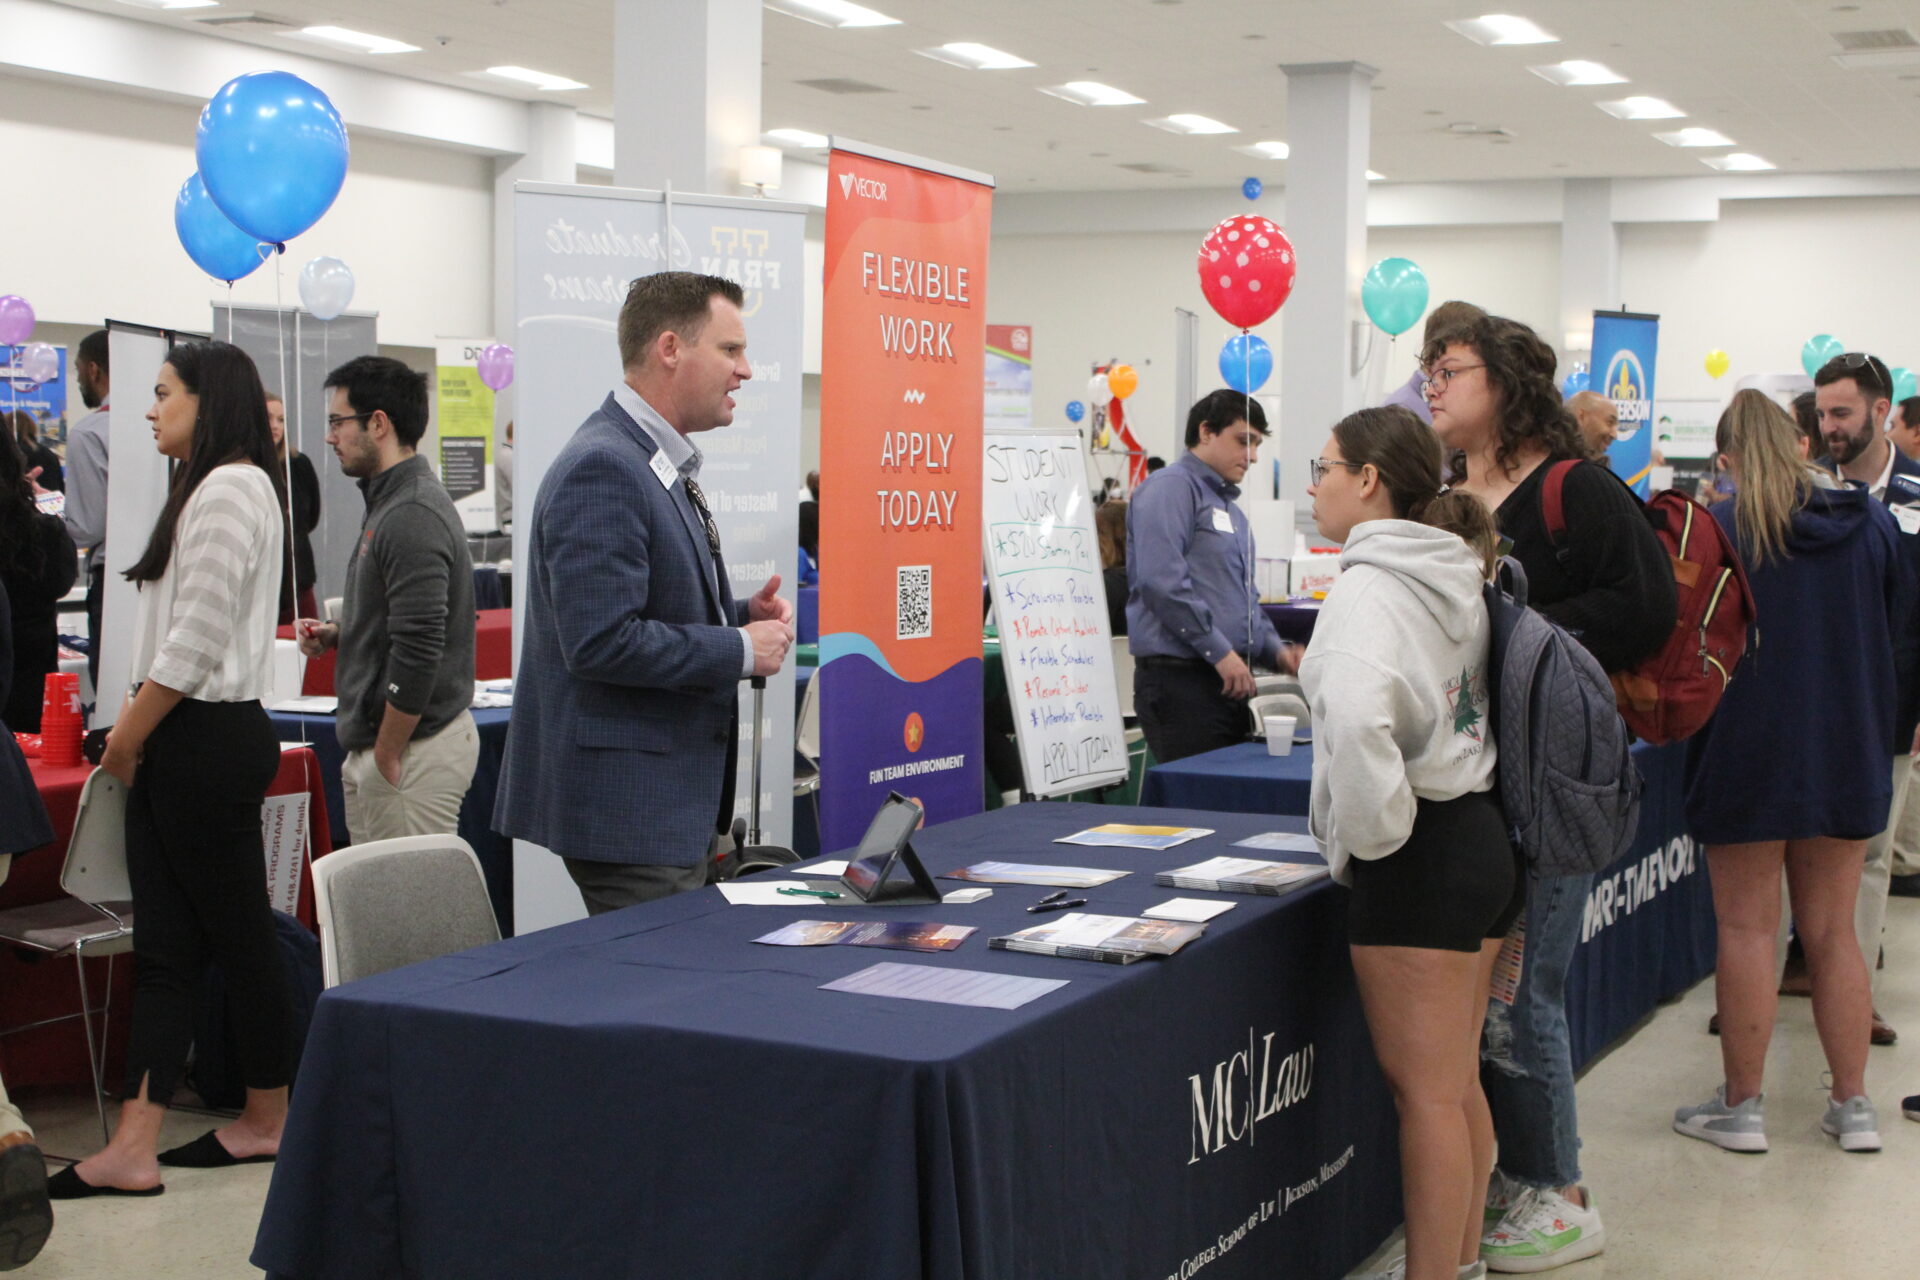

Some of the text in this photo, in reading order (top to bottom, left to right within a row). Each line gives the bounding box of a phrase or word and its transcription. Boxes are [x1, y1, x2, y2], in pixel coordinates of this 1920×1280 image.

[855, 177, 887, 201] VECTOR
[863, 251, 970, 305] FLEXIBLE
[880, 313, 955, 361] WORK
[881, 431, 955, 470] APPLY
[986, 444, 1077, 483] STUDENT
[877, 490, 958, 529] TODAY
[869, 754, 965, 785] FUN TEAM ENVIRONMENT
[1042, 739, 1080, 783] APPLY
[268, 803, 286, 881] PROGRAMS
[292, 837, 303, 853] for
